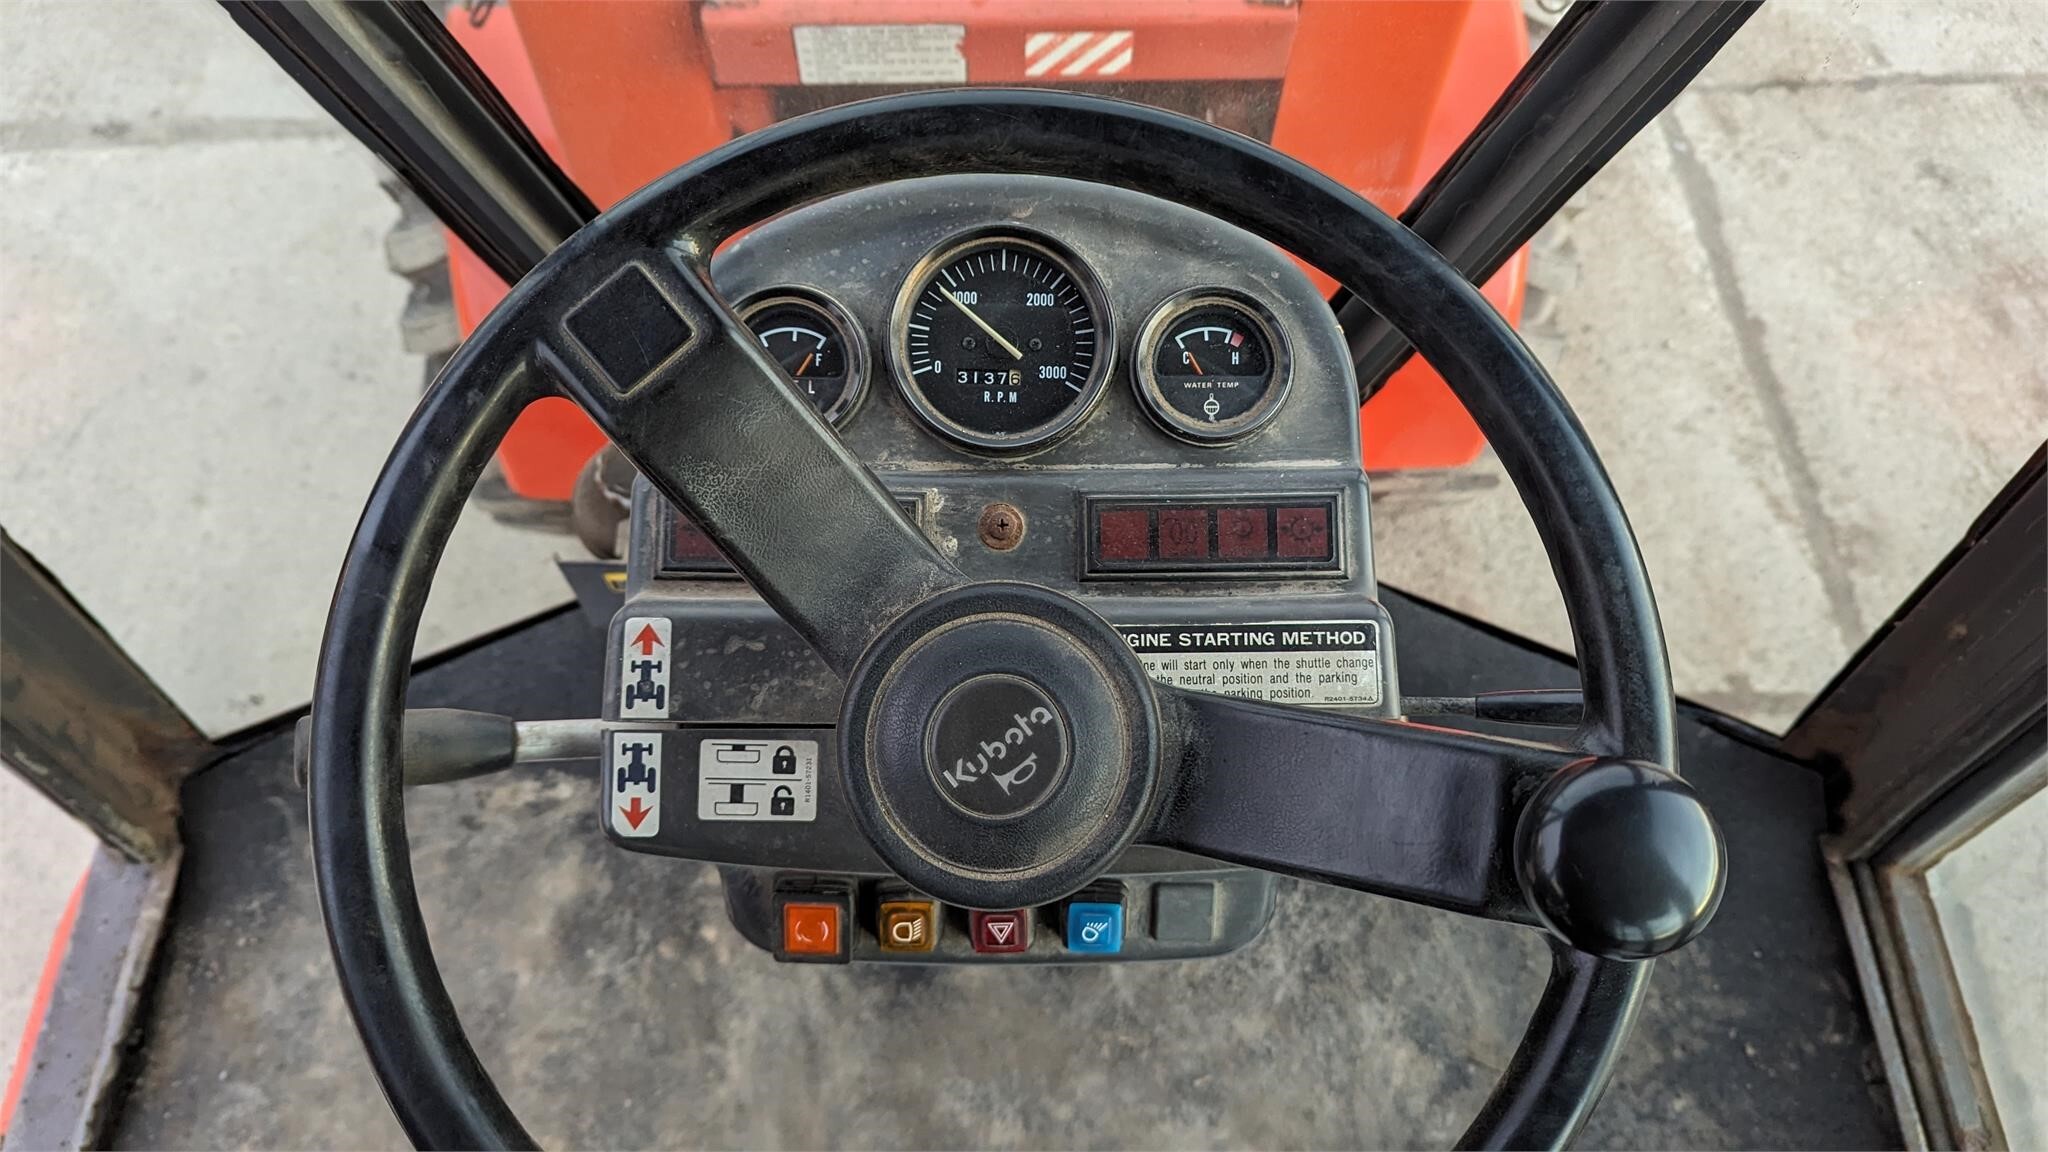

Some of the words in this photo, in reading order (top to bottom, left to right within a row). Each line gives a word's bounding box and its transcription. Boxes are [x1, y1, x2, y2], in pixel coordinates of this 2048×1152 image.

[952, 291, 977, 305] 1000
[1026, 293, 1054, 306] 2000
[815, 353, 822, 367] F
[1182, 351, 1191, 365] C
[1231, 351, 1240, 365] H
[934, 360, 942, 374] 0
[1039, 366, 1067, 379] 3000
[957, 370, 1021, 385] 31376
[1217, 381, 1239, 389] TEMP
[1123, 633, 1172, 647] GINE
[1179, 632, 1275, 647] STARTING
[1282, 631, 1366, 645] METHOD
[1161, 659, 1178, 671] will
[1184, 659, 1206, 671] start
[1213, 659, 1235, 672] only
[1240, 658, 1268, 670] when
[1274, 658, 1290, 669] the
[1296, 657, 1331, 669] shuttle
[1336, 656, 1374, 670] change
[1179, 673, 1216, 685] neutral
[1222, 673, 1263, 687] position
[1270, 672, 1289, 684] and
[1295, 672, 1312, 684] the
[1318, 671, 1358, 685] parking
[943, 707, 1053, 788] Kubota
